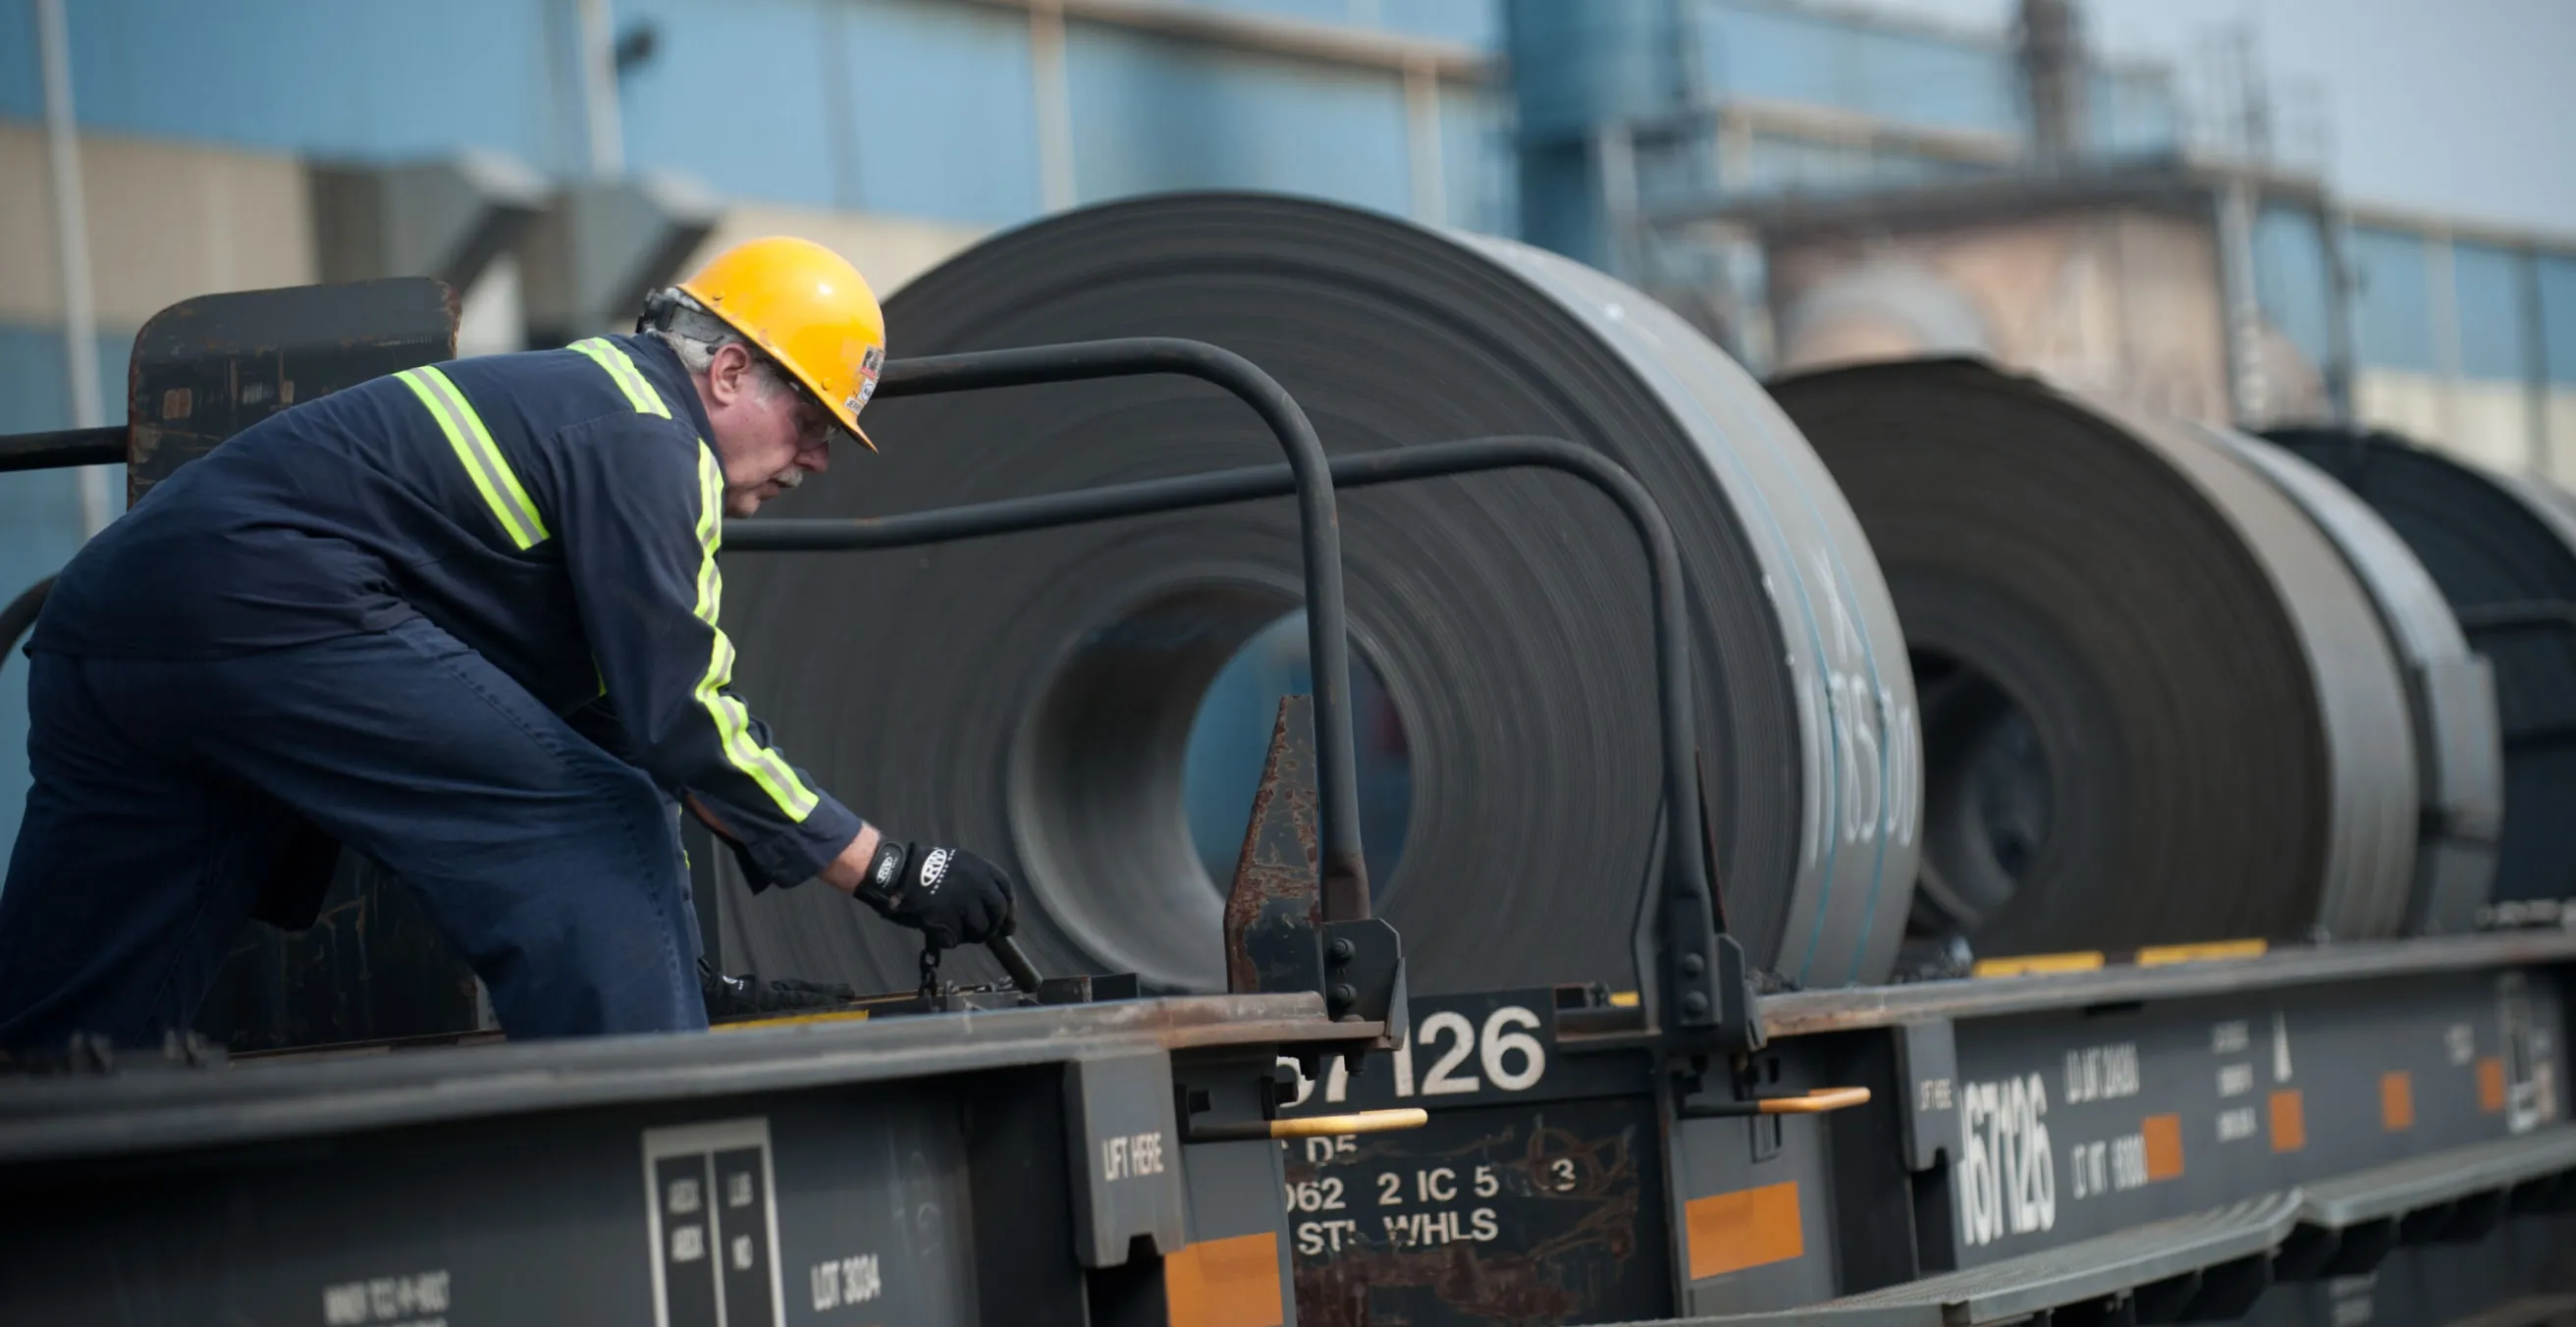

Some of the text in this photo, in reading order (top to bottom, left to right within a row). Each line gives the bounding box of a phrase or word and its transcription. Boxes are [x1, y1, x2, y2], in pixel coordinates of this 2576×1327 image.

[1103, 1132, 1164, 1182] LIFT HERE
[1377, 1172, 1403, 1205] 2
[1475, 1165, 1499, 1197] 5
